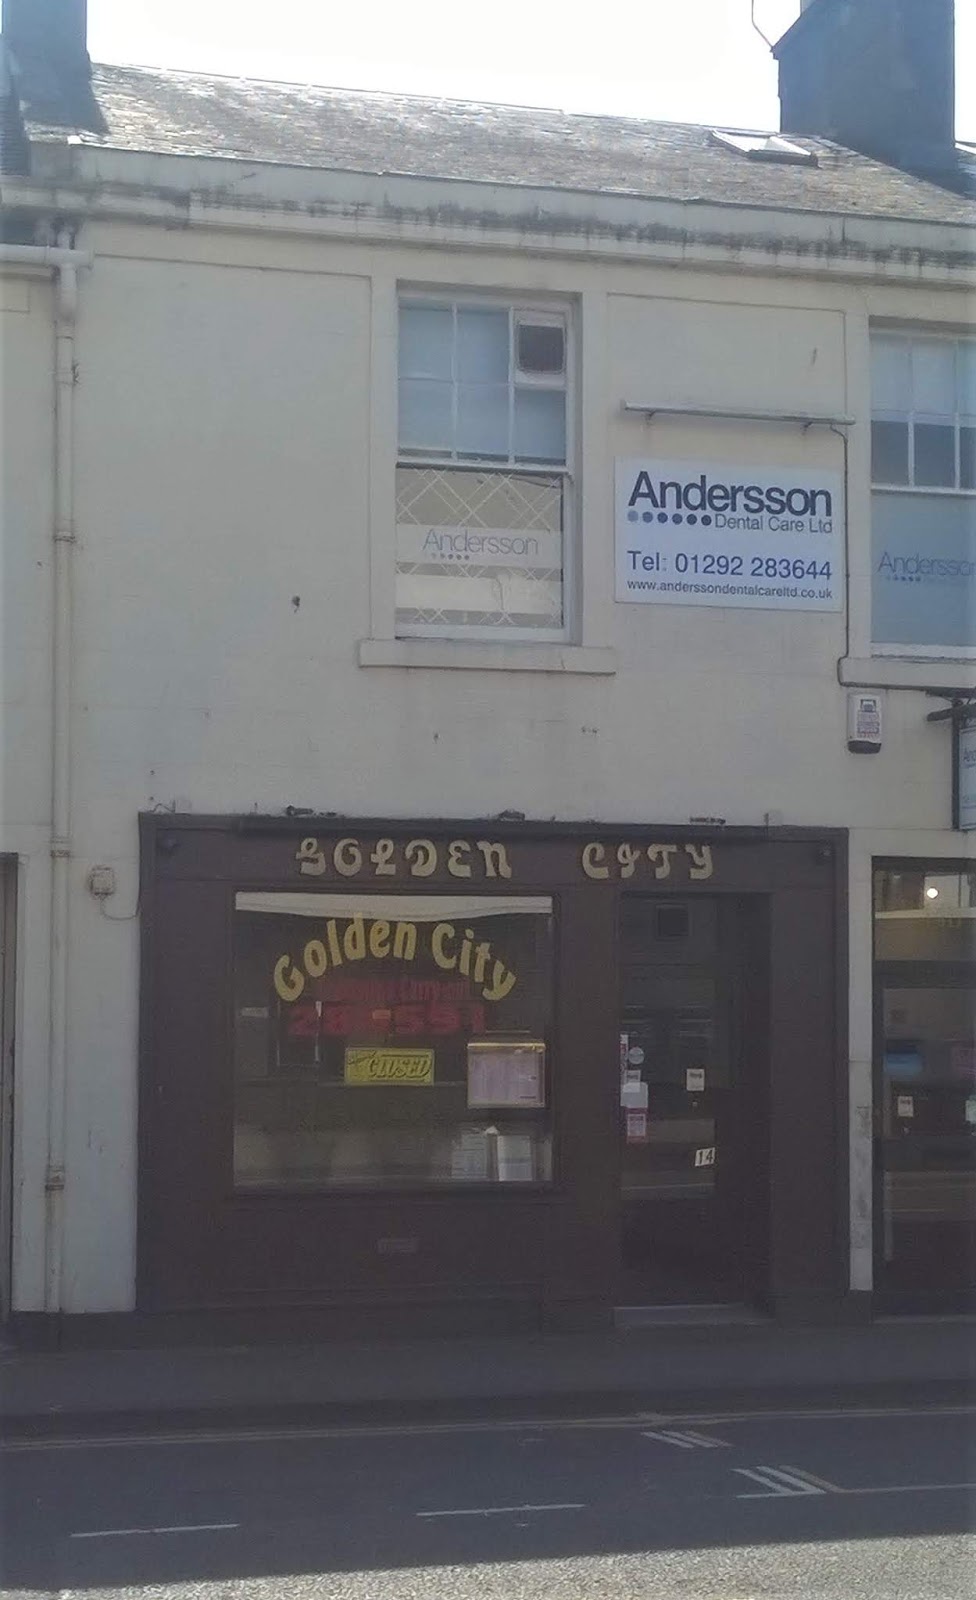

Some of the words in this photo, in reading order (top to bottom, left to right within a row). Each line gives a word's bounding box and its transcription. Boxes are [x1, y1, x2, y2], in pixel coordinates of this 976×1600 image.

[628, 471, 832, 517] Andersson
[715, 513, 763, 530] Dental
[768, 516, 804, 532] Care
[809, 518, 832, 534] Ltd
[422, 528, 538, 555] Andersson
[627, 550, 667, 572] Tel:
[675, 553, 743, 576] 01292
[750, 557, 832, 580] 283644
[627, 580, 832, 600] www.anderssondentalcareltd.co.uk
[296, 837, 512, 879] GOLDEN
[582, 841, 714, 880] CITY
[274, 912, 417, 1001] Golden
[431, 922, 517, 1001] City
[368, 1057, 432, 1079] CLOSED
[698, 1149, 714, 1165] 14
